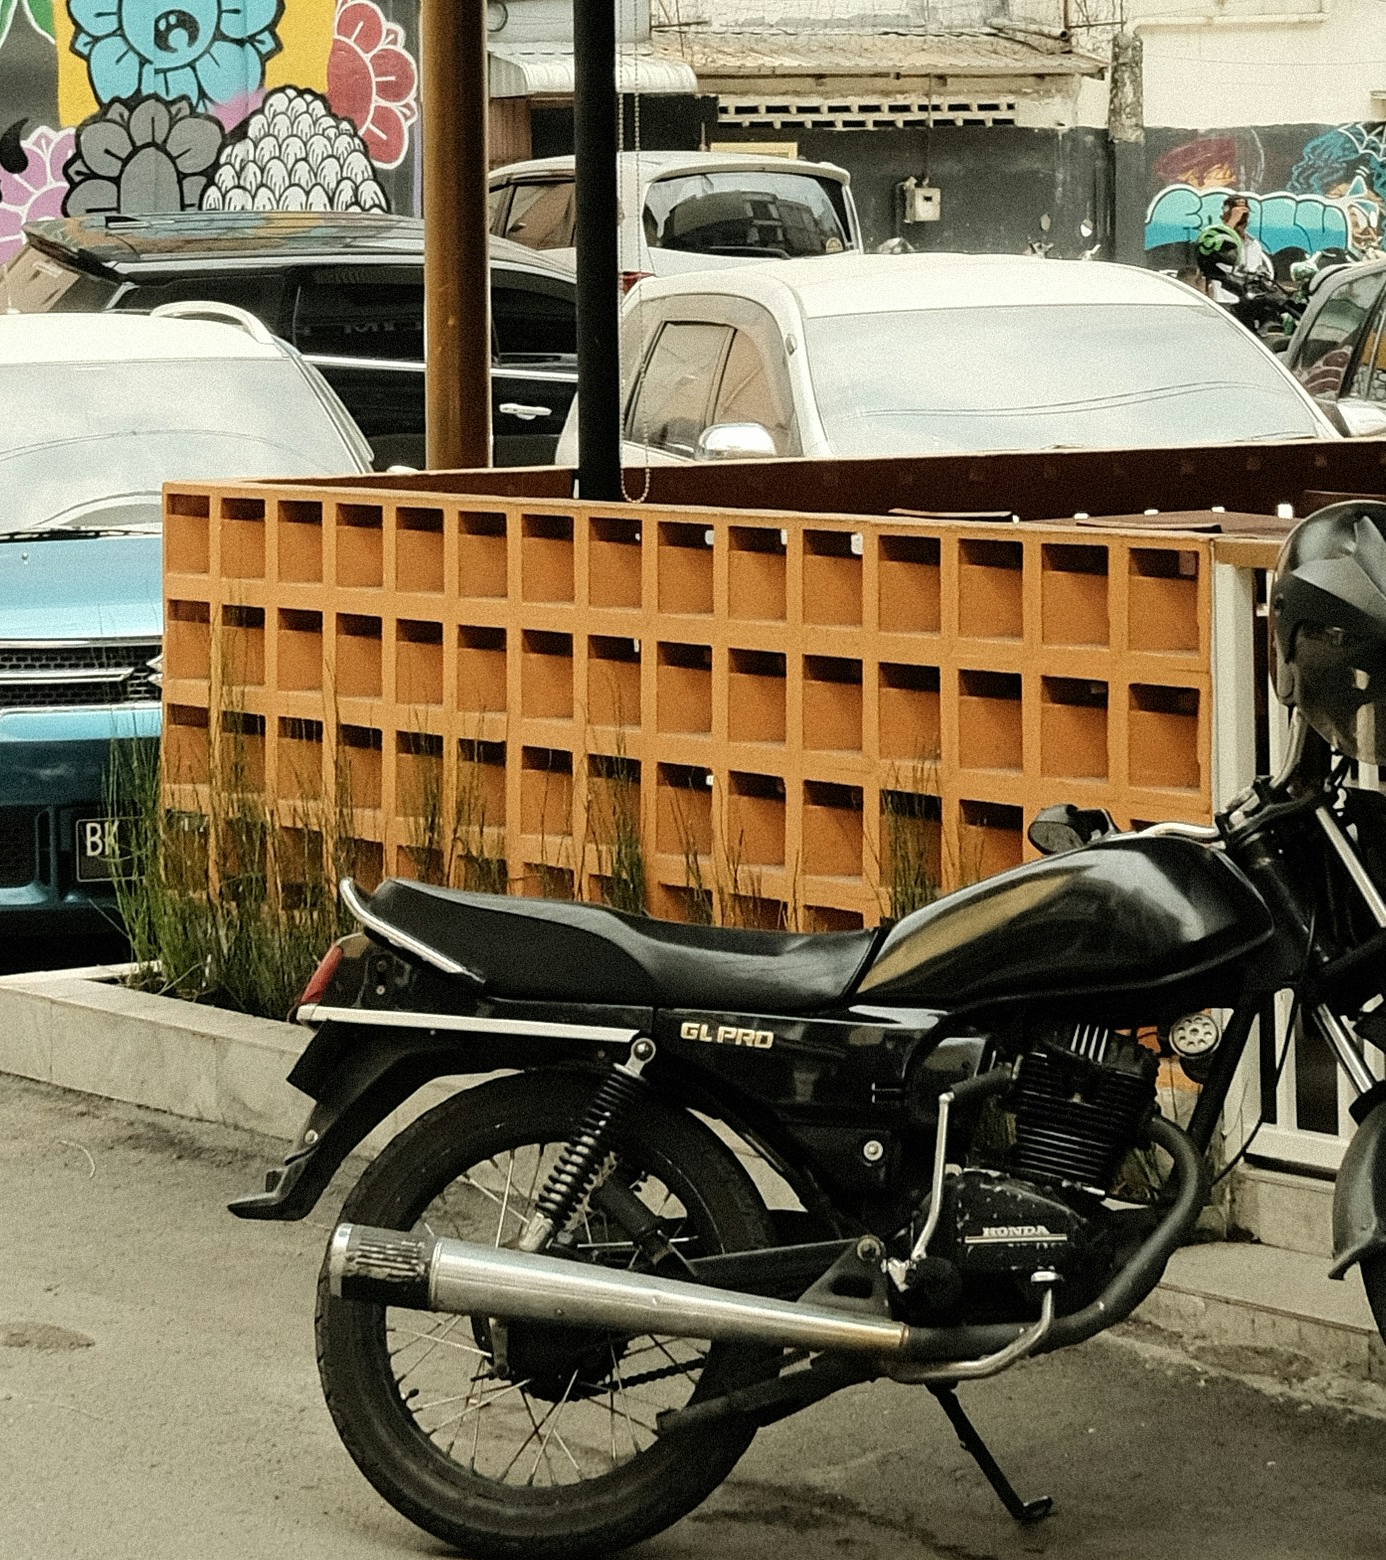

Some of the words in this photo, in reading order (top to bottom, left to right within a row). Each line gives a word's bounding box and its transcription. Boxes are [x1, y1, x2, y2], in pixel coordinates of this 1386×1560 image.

[85, 821, 120, 857] BK
[680, 1022, 712, 1043] GL
[717, 1026, 774, 1049] PRO
[983, 1225, 1050, 1237] HONDA
